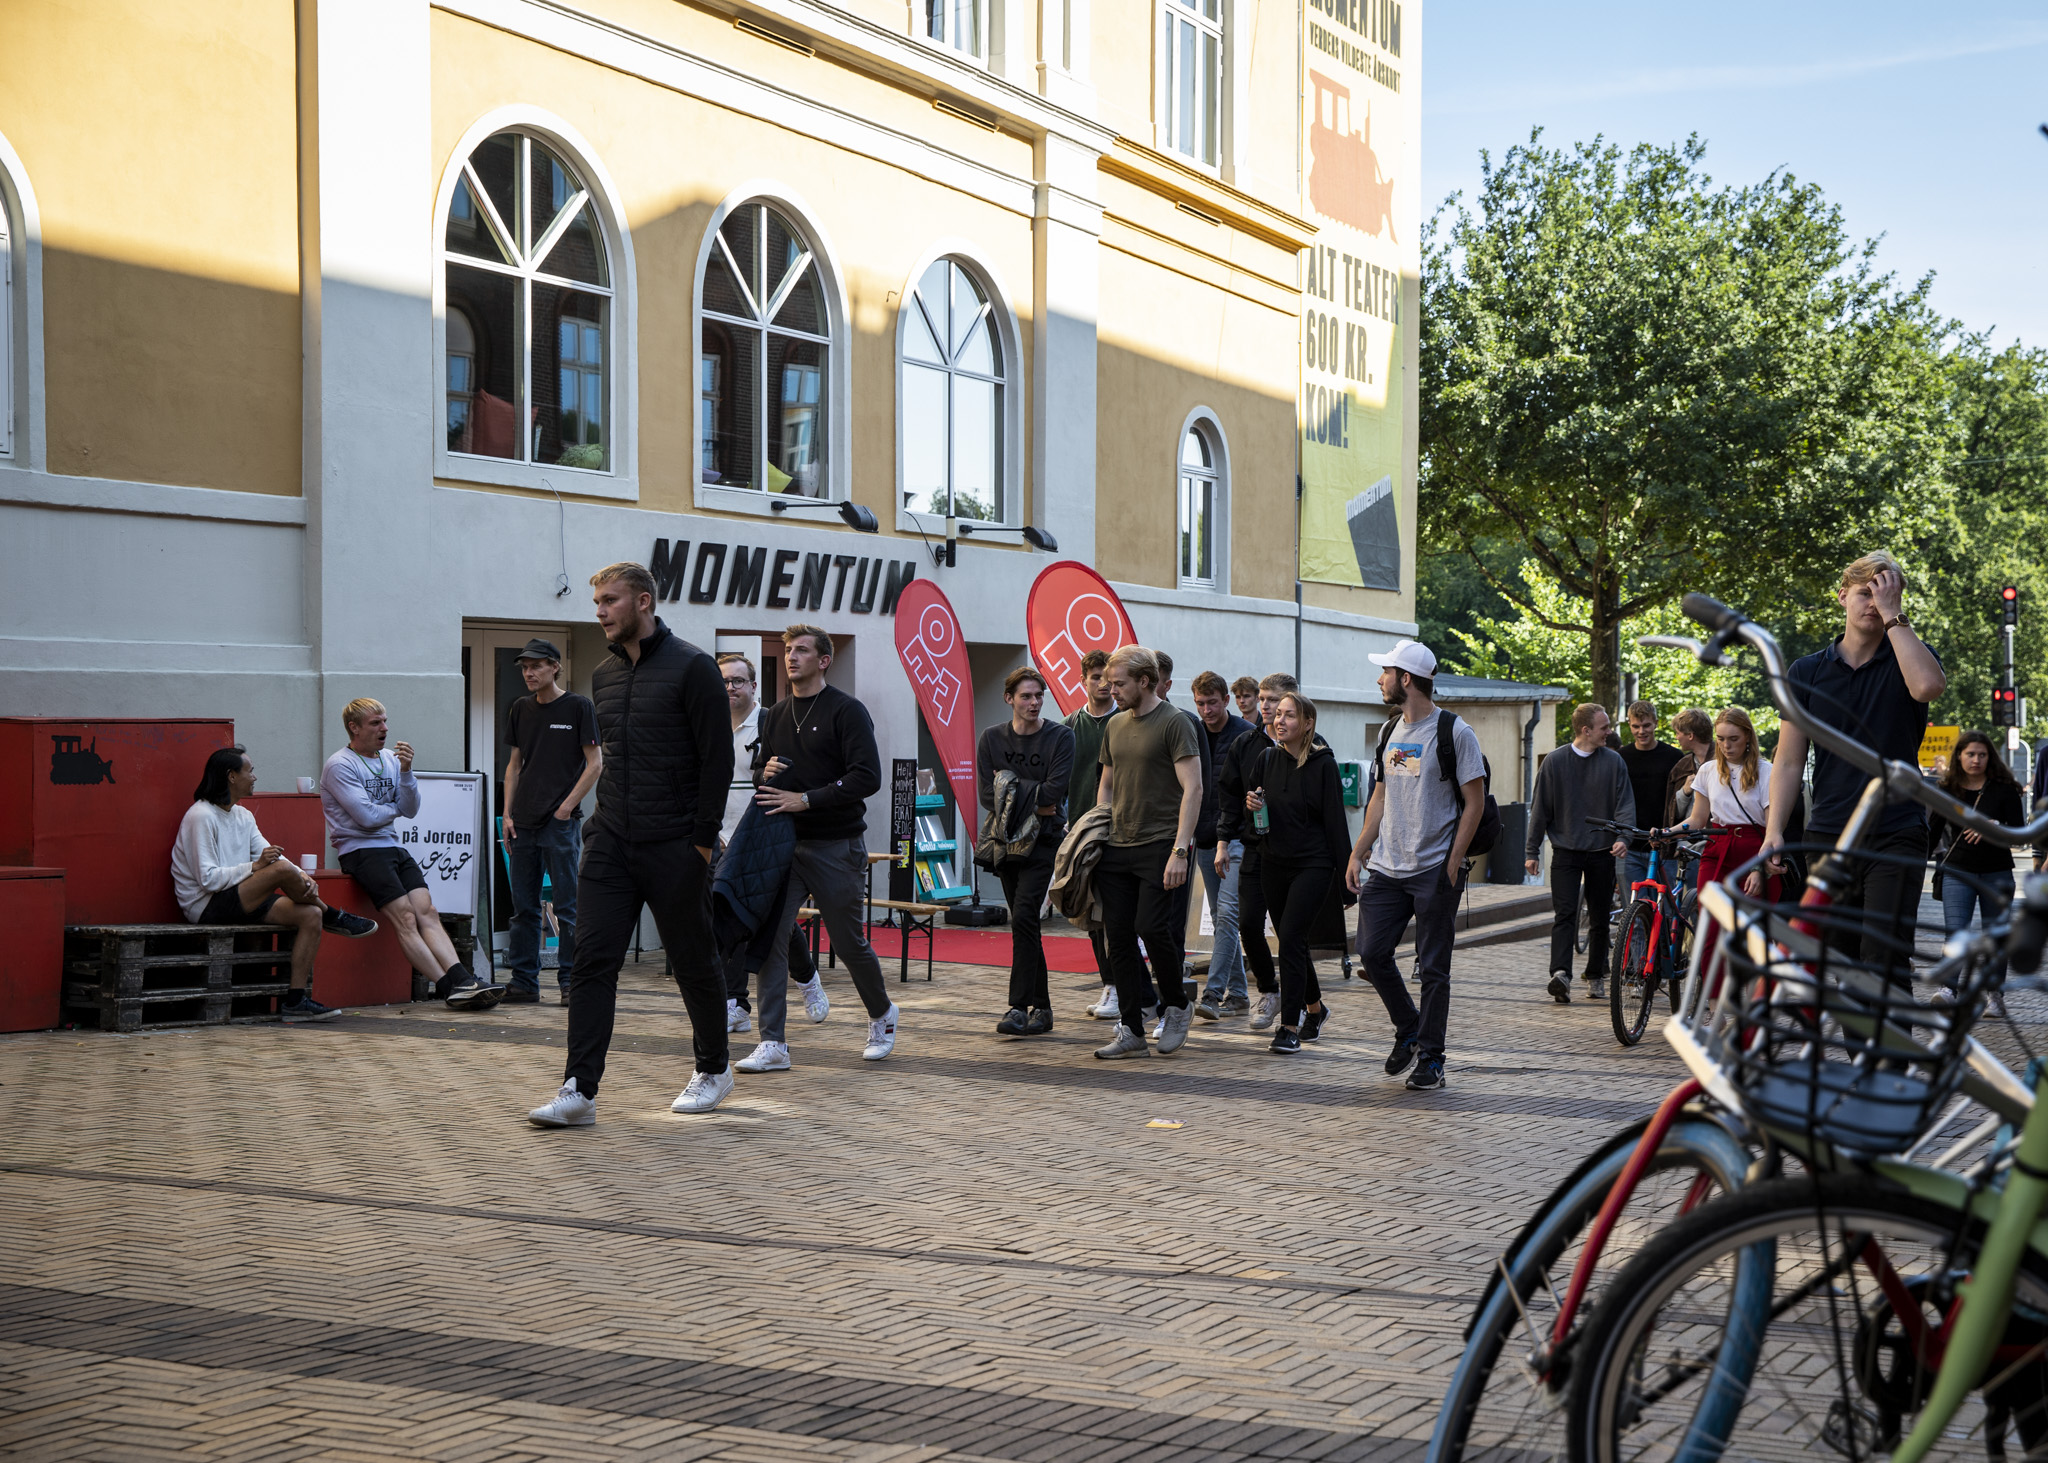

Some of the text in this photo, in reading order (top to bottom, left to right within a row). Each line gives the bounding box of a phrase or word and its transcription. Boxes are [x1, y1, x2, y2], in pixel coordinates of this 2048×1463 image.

[1310, 0, 1400, 58] ENTUM
[1310, 21, 1339, 60] VERDENS
[1341, 40, 1371, 78] VILDESTE
[1307, 244, 1399, 325] ALT TEATER
[1306, 308, 1373, 384] 600 KR.
[1305, 382, 1348, 449] KOM!
[1346, 474, 1392, 522] MOMENTUM
[650, 538, 917, 614] MOMENTUM
[402, 825, 471, 845] på Jorden
